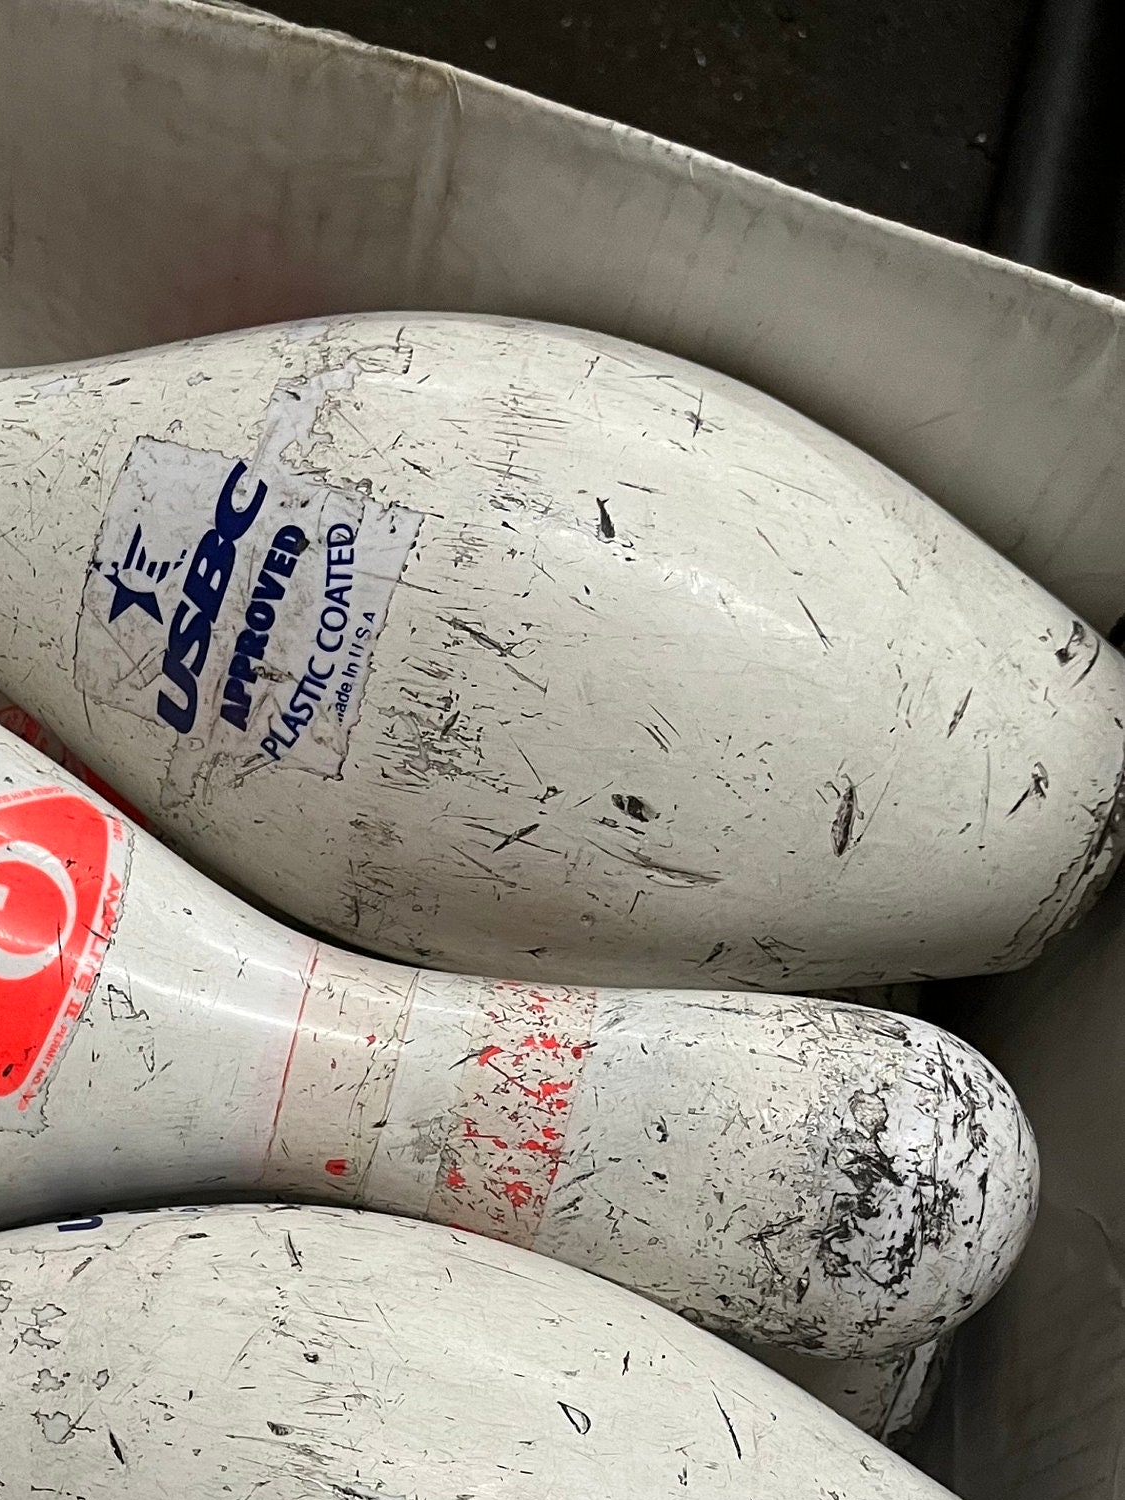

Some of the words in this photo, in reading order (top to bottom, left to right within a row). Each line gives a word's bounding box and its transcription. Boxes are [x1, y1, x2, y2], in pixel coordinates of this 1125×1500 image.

[157, 461, 268, 734] USBC
[220, 524, 307, 732] APPROVED
[260, 656, 335, 760] PLASTIC
[316, 523, 355, 653] COATED
